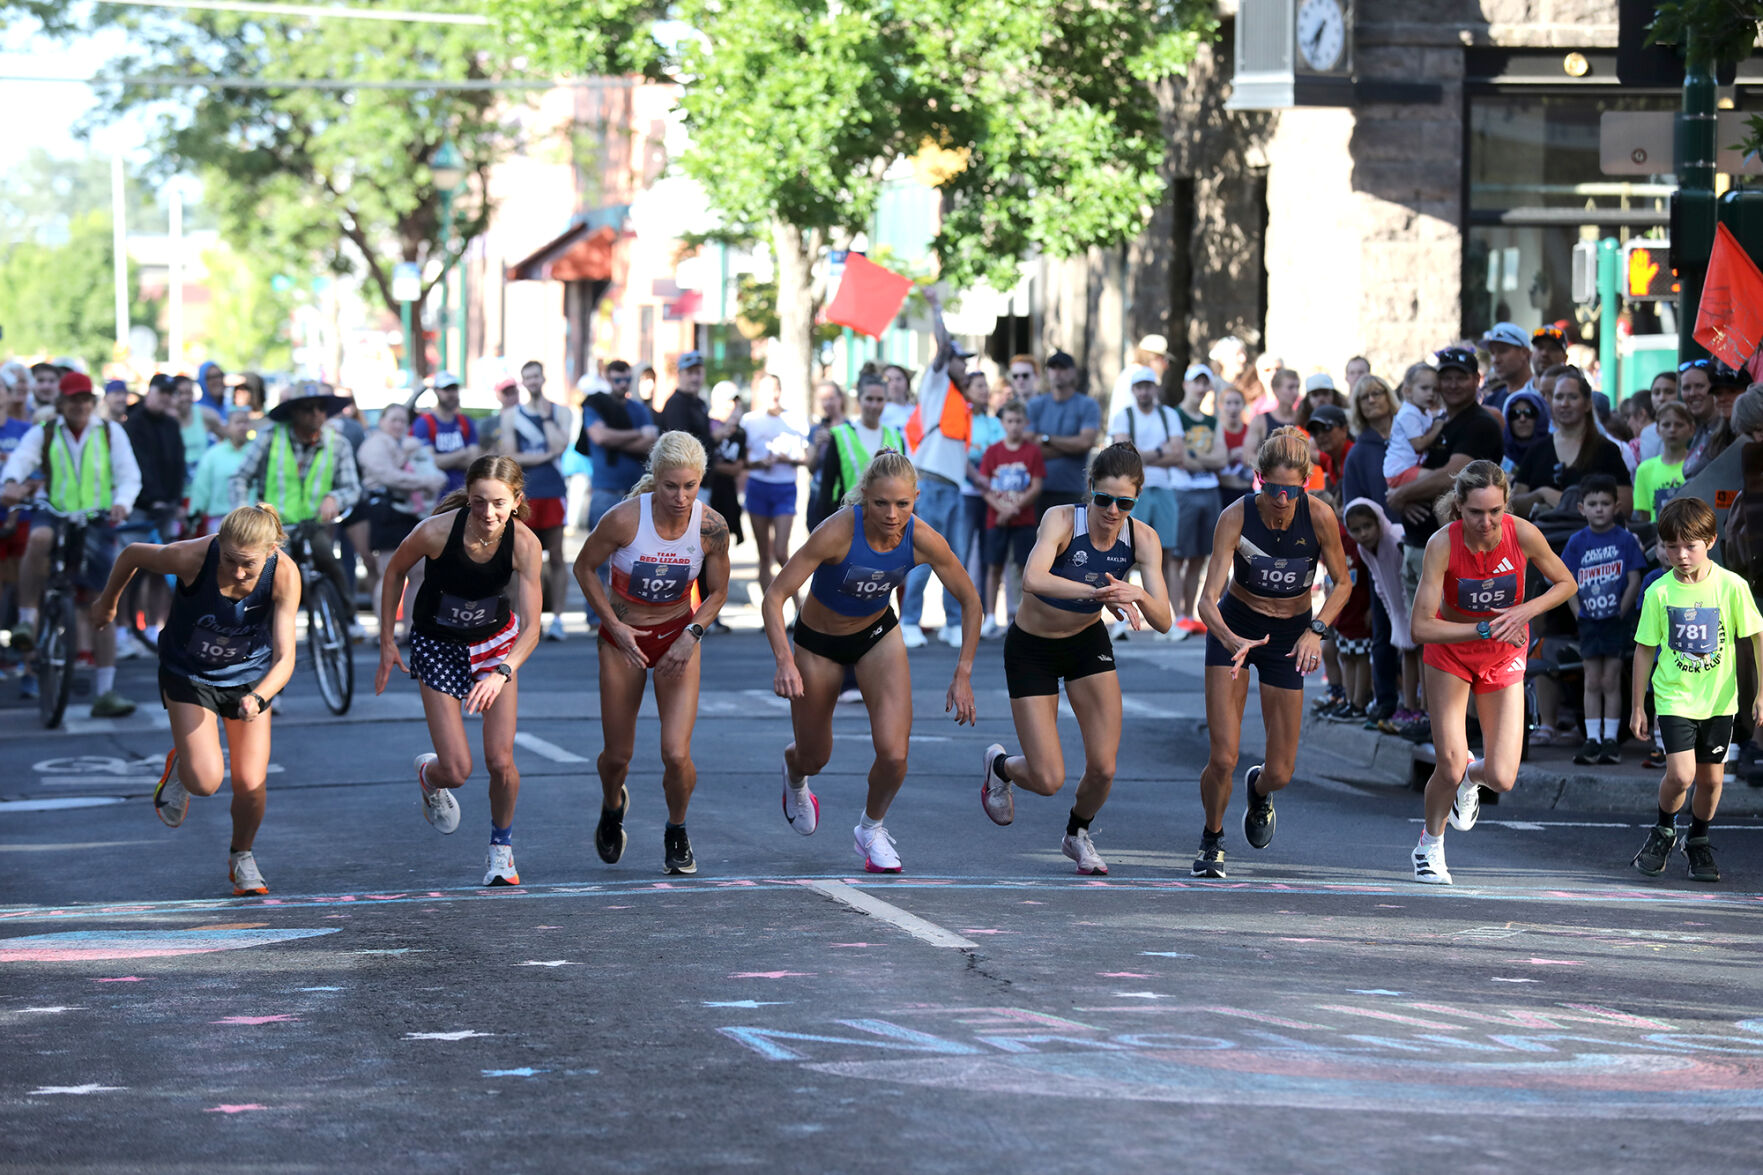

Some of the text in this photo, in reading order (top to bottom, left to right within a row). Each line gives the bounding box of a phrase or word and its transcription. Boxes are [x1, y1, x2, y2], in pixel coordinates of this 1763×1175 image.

[660, 557, 691, 565] LIZARD
[1261, 569, 1296, 583] 106
[642, 577, 677, 592] 107
[856, 581, 891, 593] 104
[1470, 590, 1505, 603] 105
[1584, 593, 1617, 611] 1002
[451, 607, 486, 621] 102
[1675, 623, 1707, 640] 781
[202, 641, 237, 658] 103
[1674, 658, 1701, 673] TRACK
